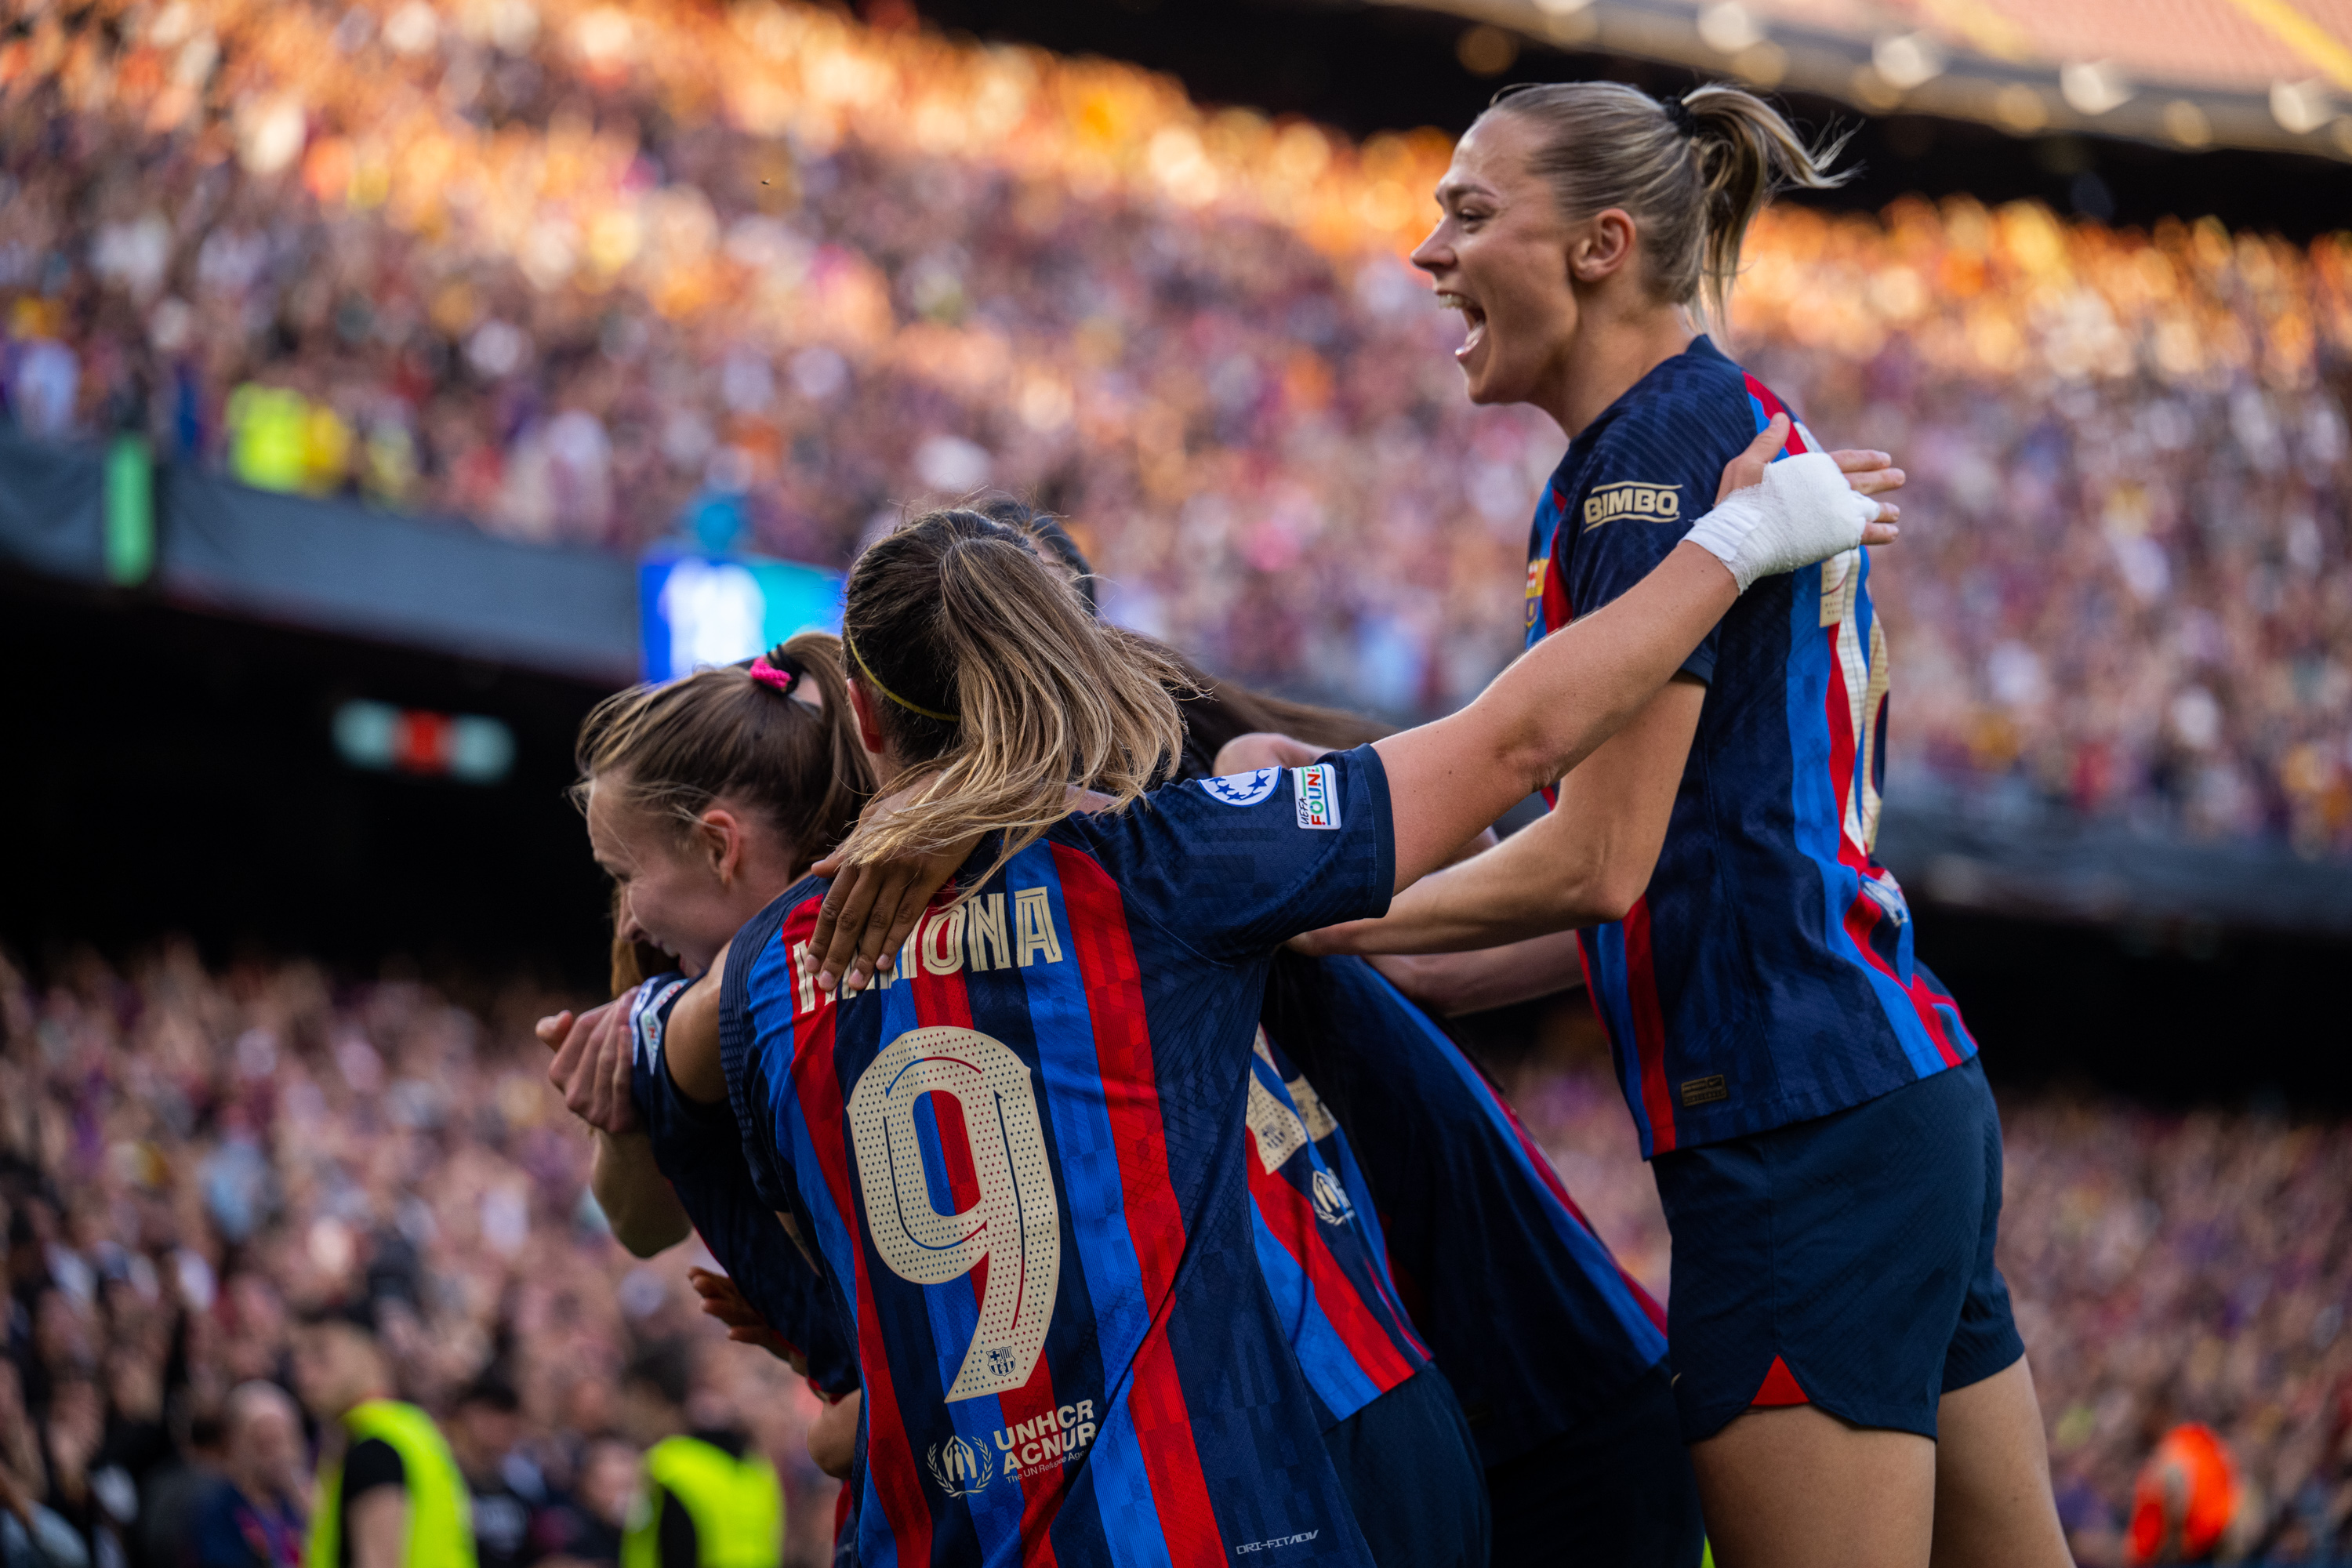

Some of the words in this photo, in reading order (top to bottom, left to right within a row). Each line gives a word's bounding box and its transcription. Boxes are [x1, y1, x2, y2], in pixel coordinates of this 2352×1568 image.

[1584, 488, 1679, 524] BIMBO
[1298, 797, 1309, 825] UEFA
[846, 1025, 1061, 1403] 9
[993, 1399, 1094, 1450] UNHCR
[1004, 1421, 1096, 1475] ACNUR
[1006, 1473, 1023, 1484] The
[1023, 1466, 1038, 1478] UN
[1039, 1456, 1067, 1472] Refugee
